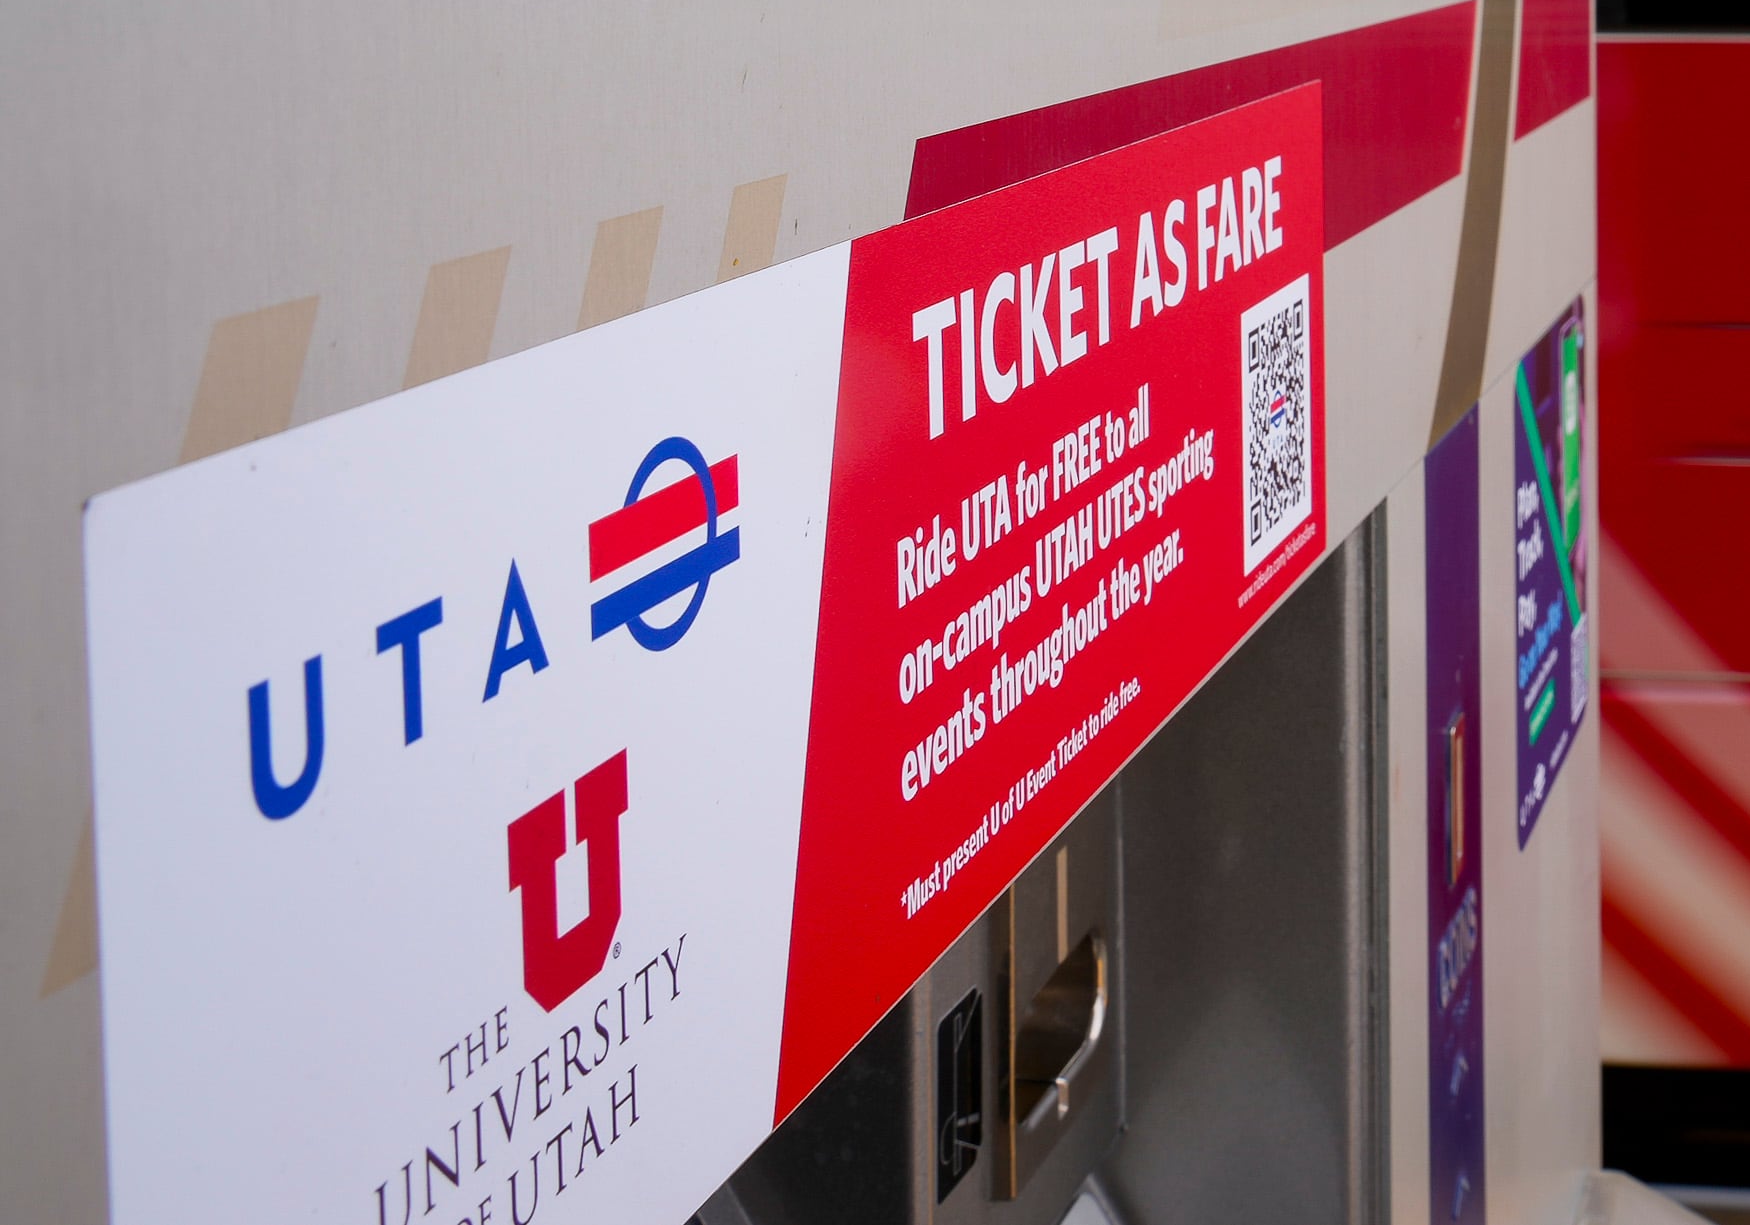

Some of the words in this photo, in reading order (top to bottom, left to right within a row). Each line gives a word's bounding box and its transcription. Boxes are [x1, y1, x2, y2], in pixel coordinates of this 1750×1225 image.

[912, 226, 1119, 441] TICKET
[1129, 198, 1188, 329] AS
[1196, 155, 1283, 291] FARE
[897, 514, 957, 609] Ride
[961, 474, 1012, 561] UTA
[1015, 460, 1049, 526] for
[1052, 414, 1102, 502] FREE
[1104, 410, 1126, 464] to
[1128, 382, 1150, 449] all
[899, 565, 1032, 705] on-campus
[1035, 502, 1094, 598] UTAH
[1097, 466, 1146, 550] UTES
[1148, 428, 1214, 518] sporting
[248, 558, 549, 821] UTA
[901, 687, 987, 802] events
[990, 578, 1108, 724] throughout
[1109, 557, 1141, 621] the
[1142, 528, 1185, 606] year.
[942, 814, 989, 892] present
[990, 801, 1000, 836] U
[1001, 786, 1015, 825] of
[1015, 777, 1025, 811] U
[1026, 750, 1057, 802] Event
[1057, 719, 1088, 770] Ticket
[1088, 713, 1100, 740] to
[1100, 691, 1119, 729] ride
[1119, 677, 1141, 710] free.
[374, 932, 687, 1225] UNIVERSITY
[438, 1005, 510, 1095] THE
[457, 1194, 492, 1225] F
[507, 1063, 640, 1225] UTAH
